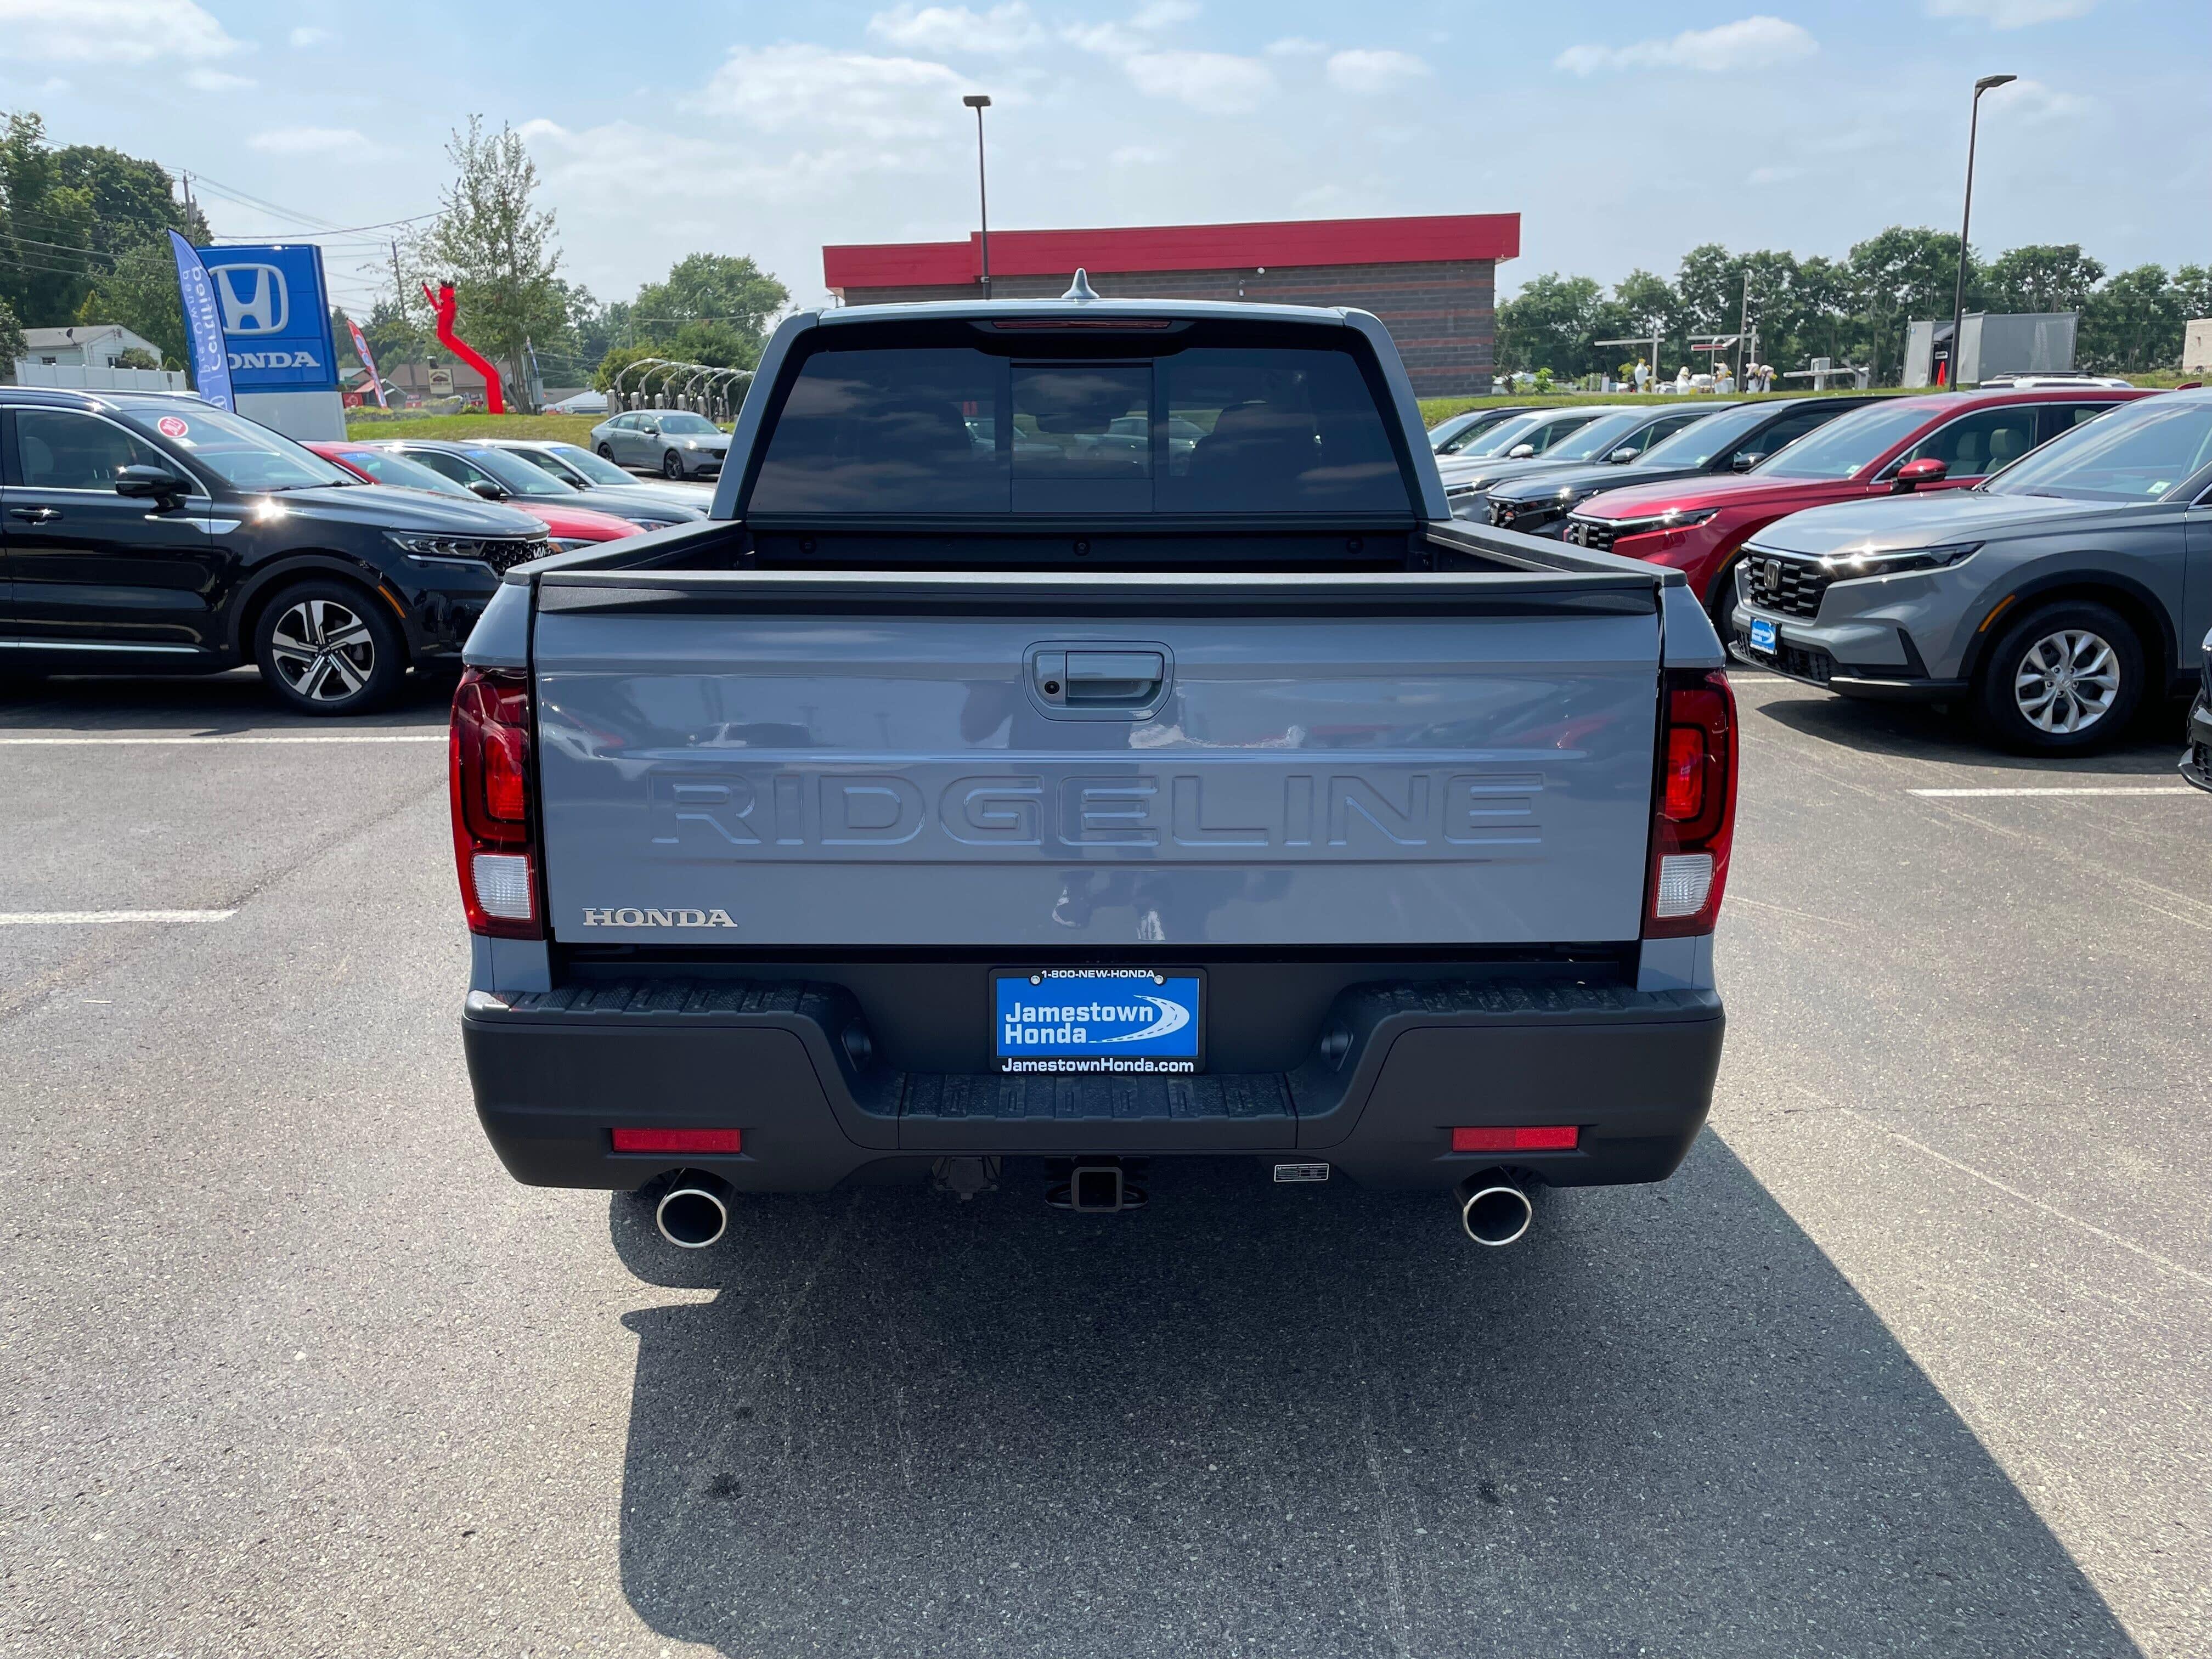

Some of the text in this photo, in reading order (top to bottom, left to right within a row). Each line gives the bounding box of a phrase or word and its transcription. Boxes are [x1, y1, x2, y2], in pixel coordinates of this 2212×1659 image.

[228, 352, 320, 370] ONDA
[646, 770, 1544, 845] RIDGELINE
[582, 907, 738, 927] HONDA
[1041, 970, 1155, 978] 1-800-NEW-HONDA
[1005, 1002, 1153, 1023] Jamestown
[1005, 1024, 1087, 1044] Honda
[1002, 1058, 1194, 1072] JamestownHonda.com
